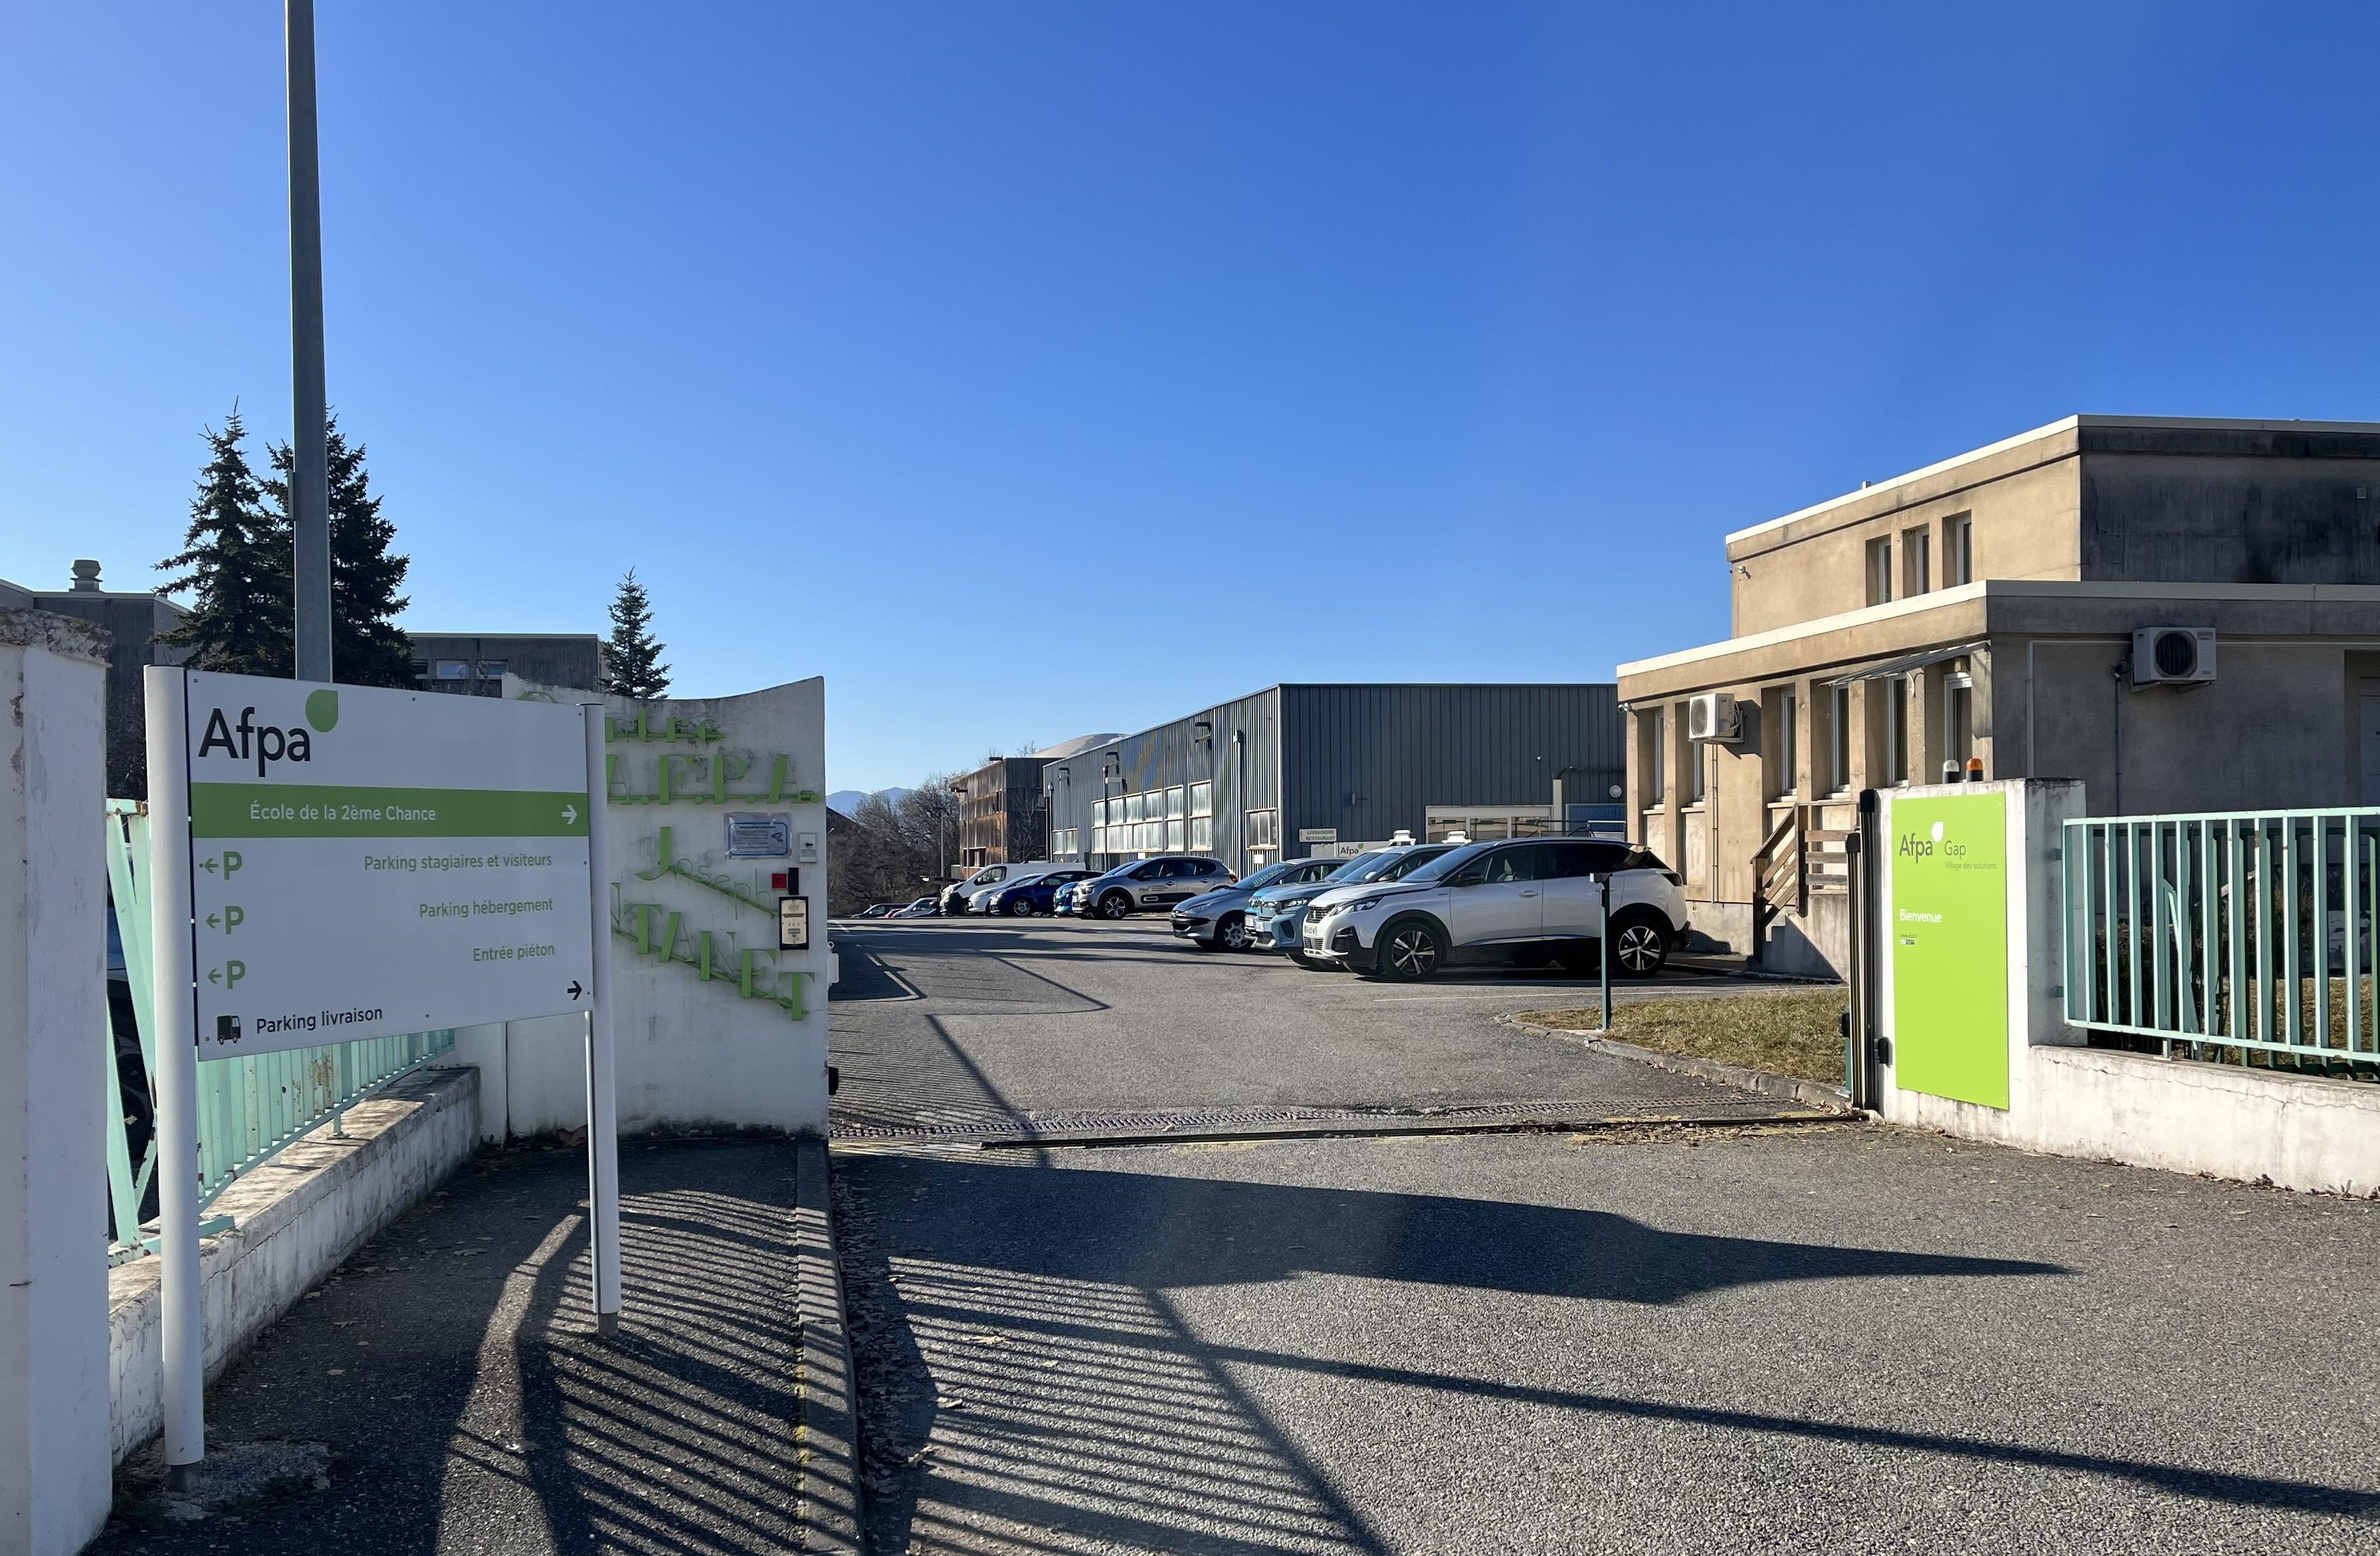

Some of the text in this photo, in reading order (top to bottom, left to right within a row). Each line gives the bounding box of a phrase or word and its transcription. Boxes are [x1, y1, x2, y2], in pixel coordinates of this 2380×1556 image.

[197, 707, 311, 777] Afpa
[250, 800, 436, 821] École de la 2ème Chance
[1340, 847, 1359, 855] Afpa
[1899, 832, 1966, 864] Afpa Gap
[223, 851, 243, 880] P
[364, 853, 552, 872] Parking stagiaires et visiteurs
[635, 825, 773, 920] Joseph
[1945, 861, 1962, 871] Village
[225, 905, 245, 935] P
[419, 898, 554, 918] Parking hébergement
[1900, 908, 1942, 923] Bienvenue
[473, 943, 554, 961] Entrée piéton
[611, 882, 815, 1021] TANET
[226, 960, 246, 990] P
[256, 1007, 383, 1034] Parking livraison
